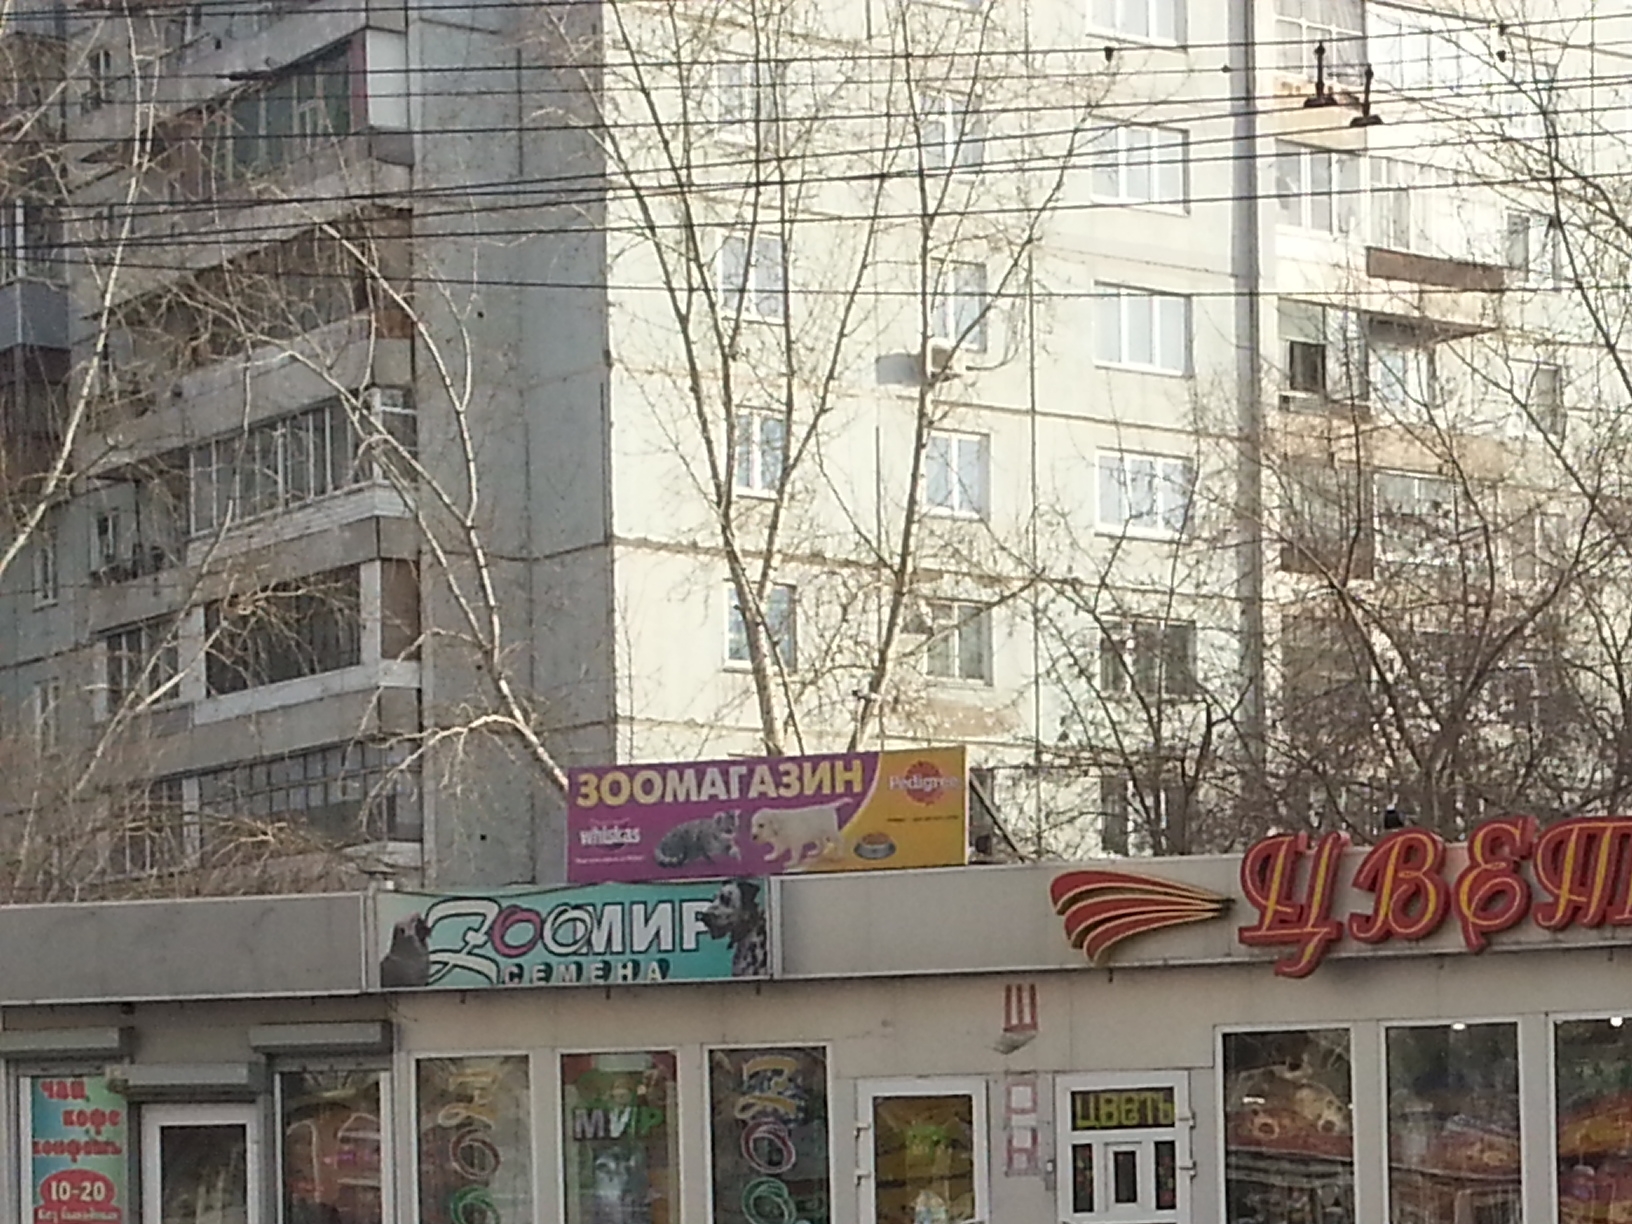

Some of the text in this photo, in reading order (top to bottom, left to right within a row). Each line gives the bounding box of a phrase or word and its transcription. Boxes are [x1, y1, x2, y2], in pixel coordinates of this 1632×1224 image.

[575, 760, 864, 807] ЗООМАГАЗИН
[503, 958, 669, 985] СЕМЕНА
[51, 1181, 106, 1201] 10-20
